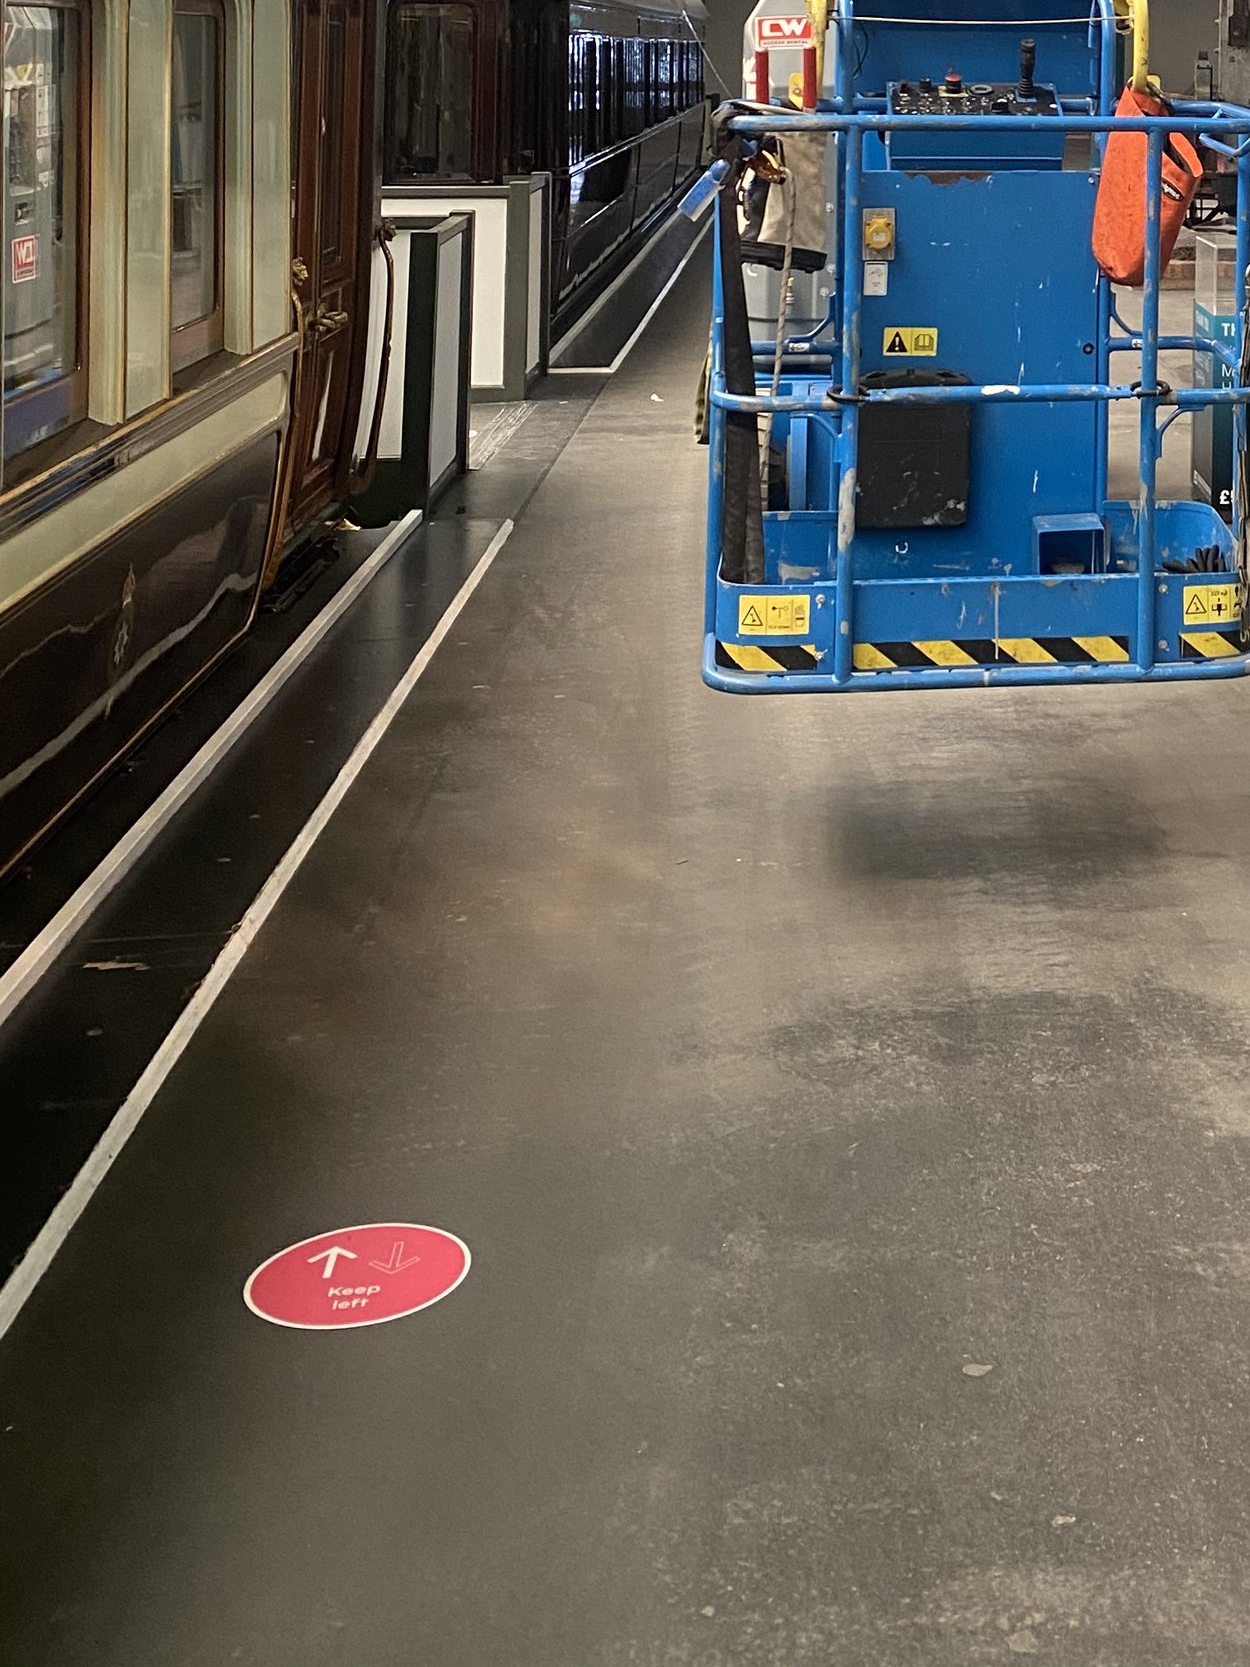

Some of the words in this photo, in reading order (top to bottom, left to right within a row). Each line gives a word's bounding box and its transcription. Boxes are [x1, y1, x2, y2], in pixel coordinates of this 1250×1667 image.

[762, 19, 807, 37] CW
[328, 1284, 382, 1298] Keep
[331, 1297, 370, 1310] left
